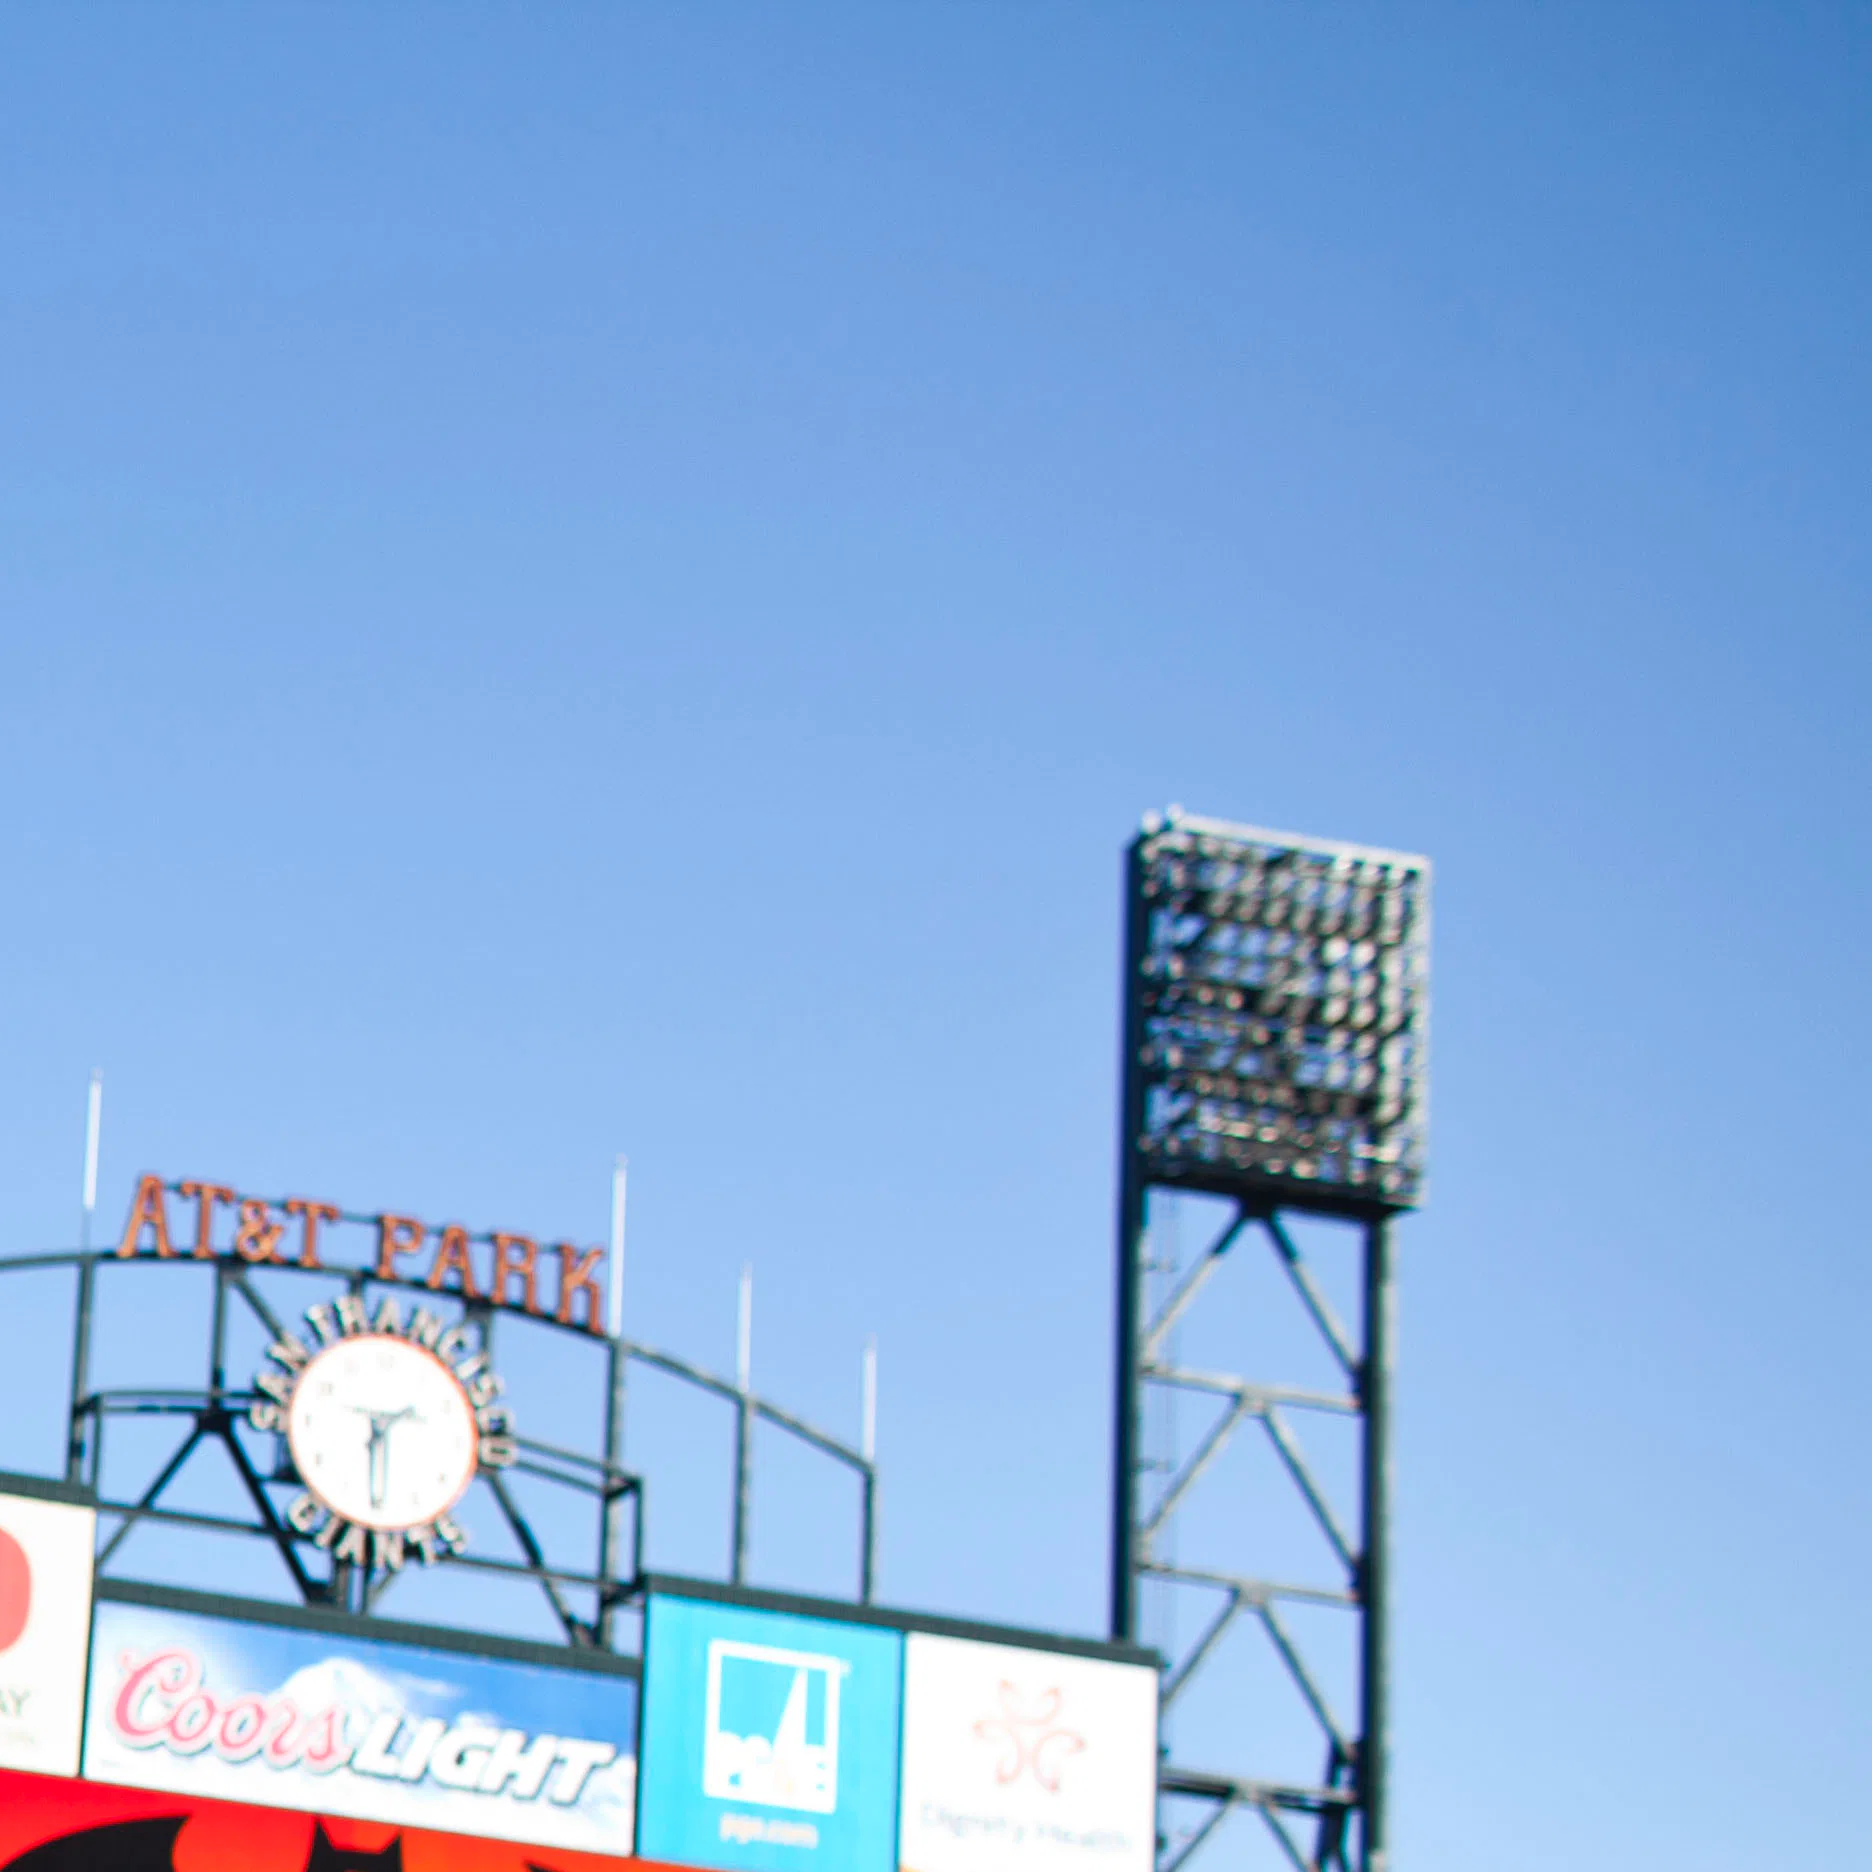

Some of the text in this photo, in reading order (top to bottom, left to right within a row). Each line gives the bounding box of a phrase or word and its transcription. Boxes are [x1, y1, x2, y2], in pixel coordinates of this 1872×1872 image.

[116, 1175, 606, 1336] AT&T PARK
[248, 1295, 519, 1466] SAN FRANCISCO
[286, 1492, 468, 1571] GIANTS
[112, 1647, 355, 1777] Coors
[351, 1712, 616, 1808] LIGHT
